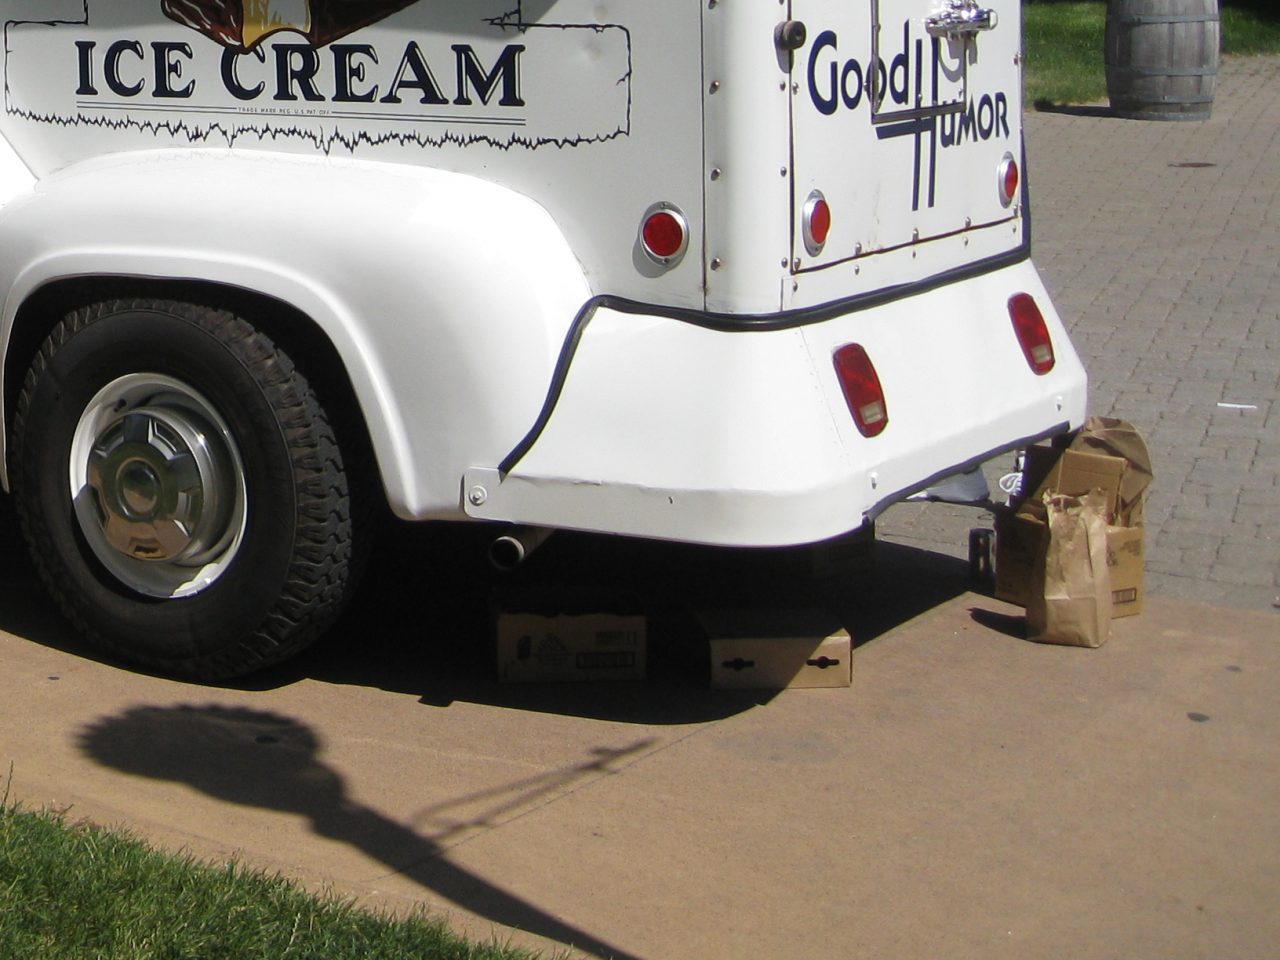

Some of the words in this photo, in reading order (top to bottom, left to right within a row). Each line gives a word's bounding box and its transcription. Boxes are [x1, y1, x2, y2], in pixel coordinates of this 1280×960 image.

[75, 40, 196, 98] ICE
[220, 40, 526, 107] CREAM
[807, 19, 910, 116] Good
